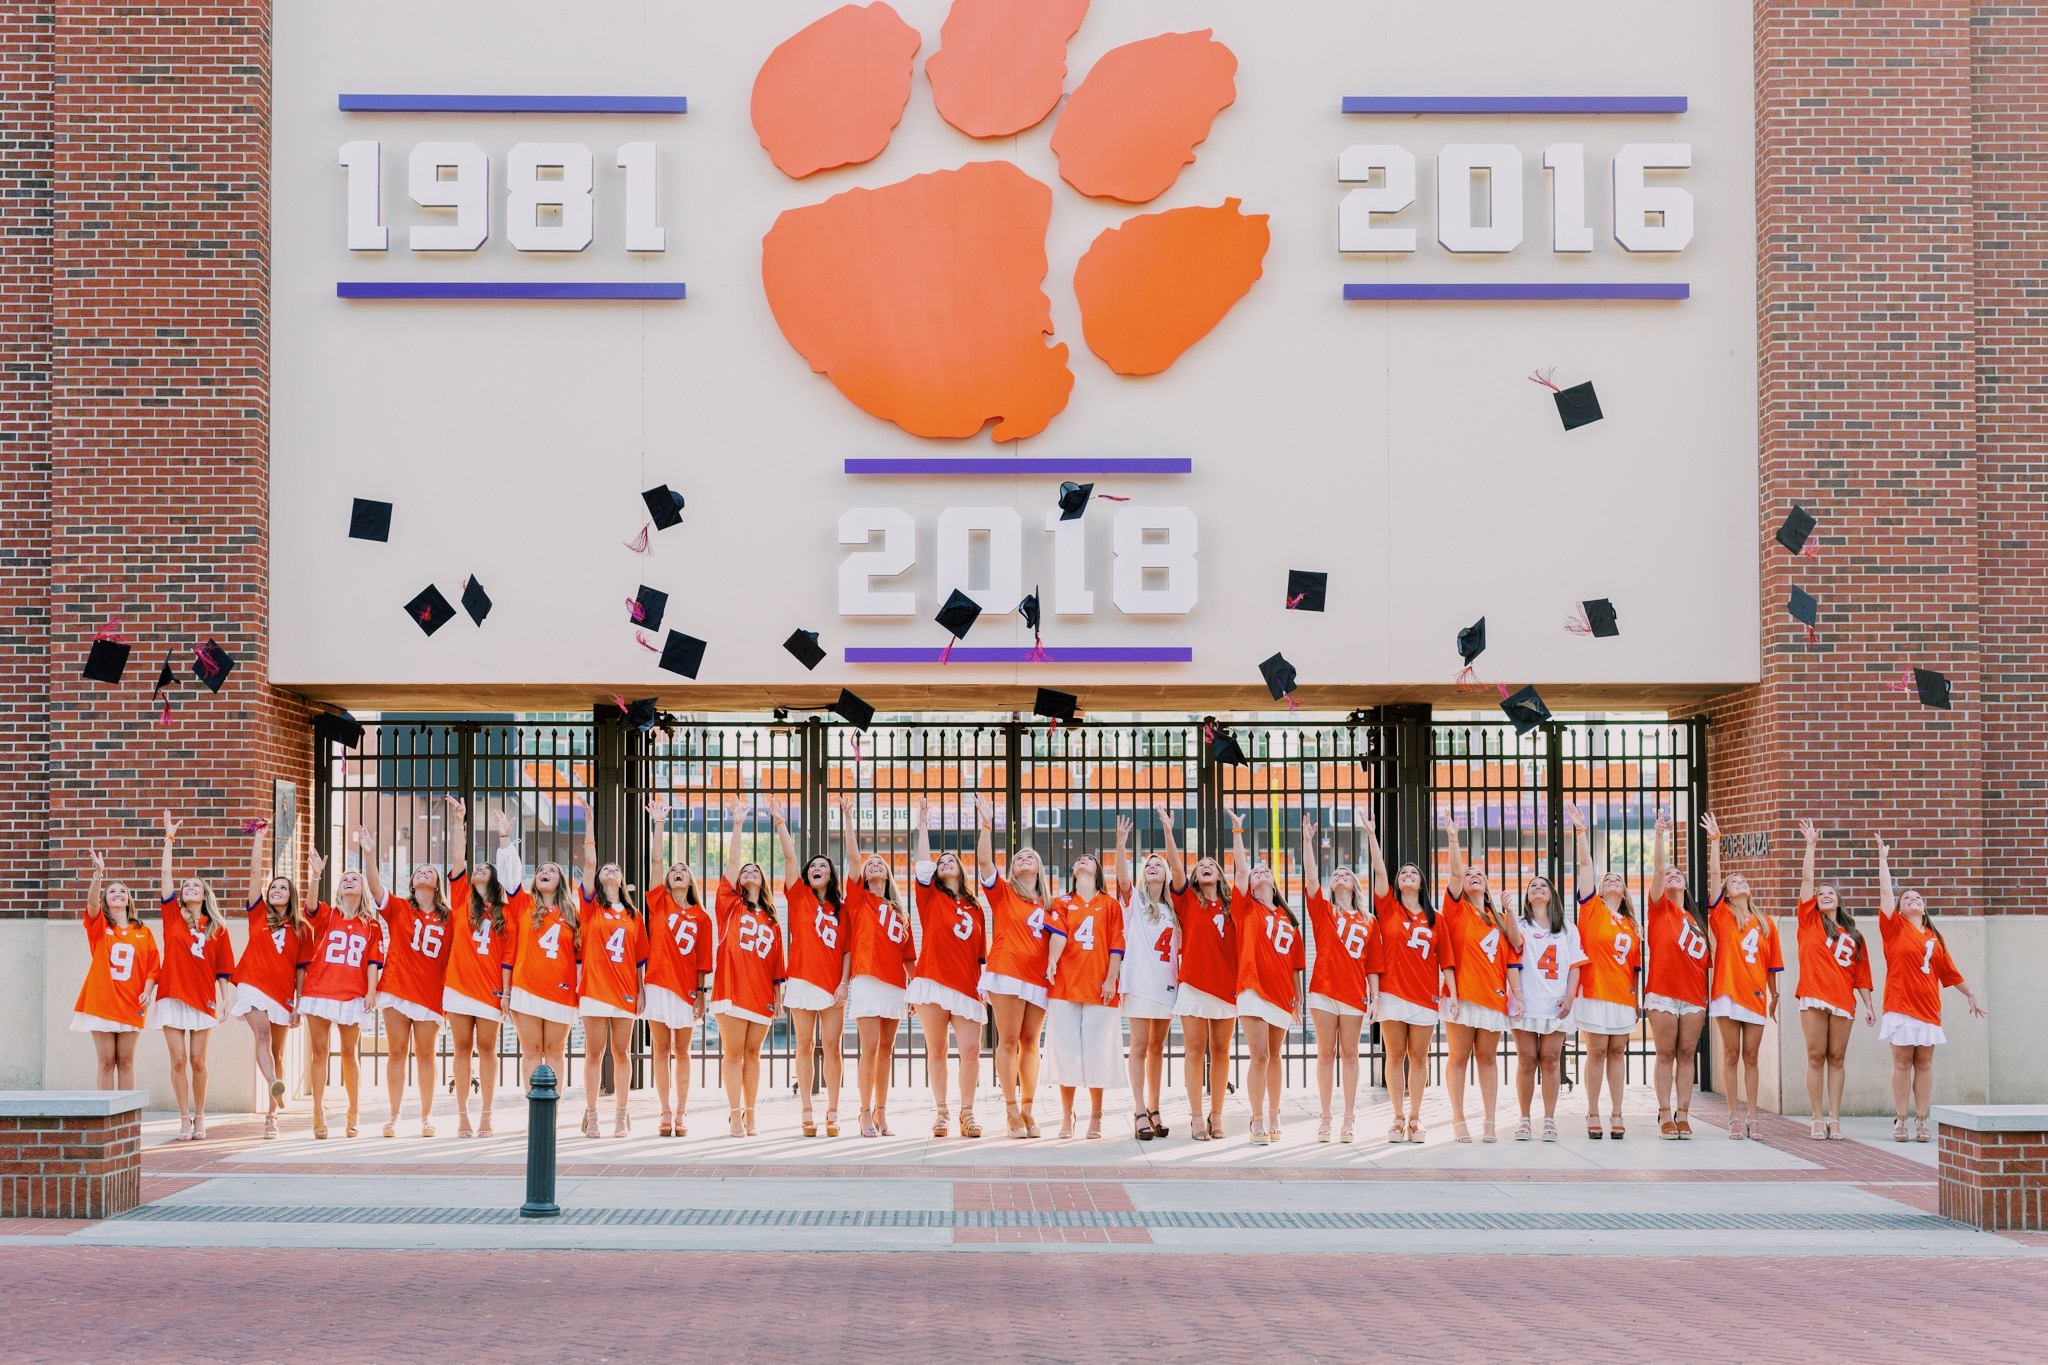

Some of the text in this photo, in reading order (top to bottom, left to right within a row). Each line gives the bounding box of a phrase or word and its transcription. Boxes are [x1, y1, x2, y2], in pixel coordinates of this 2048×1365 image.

[339, 141, 665, 252] 1981
[1338, 143, 1694, 253] 2016
[839, 506, 1198, 615] 2018
[1722, 832, 1769, 857] POE PLAZA
[410, 918, 445, 959] 16
[472, 918, 491, 956] 4
[539, 923, 562, 960] 4
[739, 914, 775, 960] 28
[878, 904, 903, 944] 16
[952, 908, 974, 941] 3
[1026, 907, 1045, 939] 4
[1074, 916, 1095, 951] 4
[1265, 915, 1295, 955] 16
[1336, 917, 1368, 960] 16
[110, 943, 135, 982] 9
[325, 930, 367, 968] 28
[605, 927, 626, 963] 4
[1154, 927, 1174, 963] 4
[1479, 928, 1500, 964] 4
[1537, 944, 1559, 980] 4
[1613, 932, 1632, 965] 9
[1741, 928, 1759, 964] 4
[1920, 940, 1935, 975] 1
